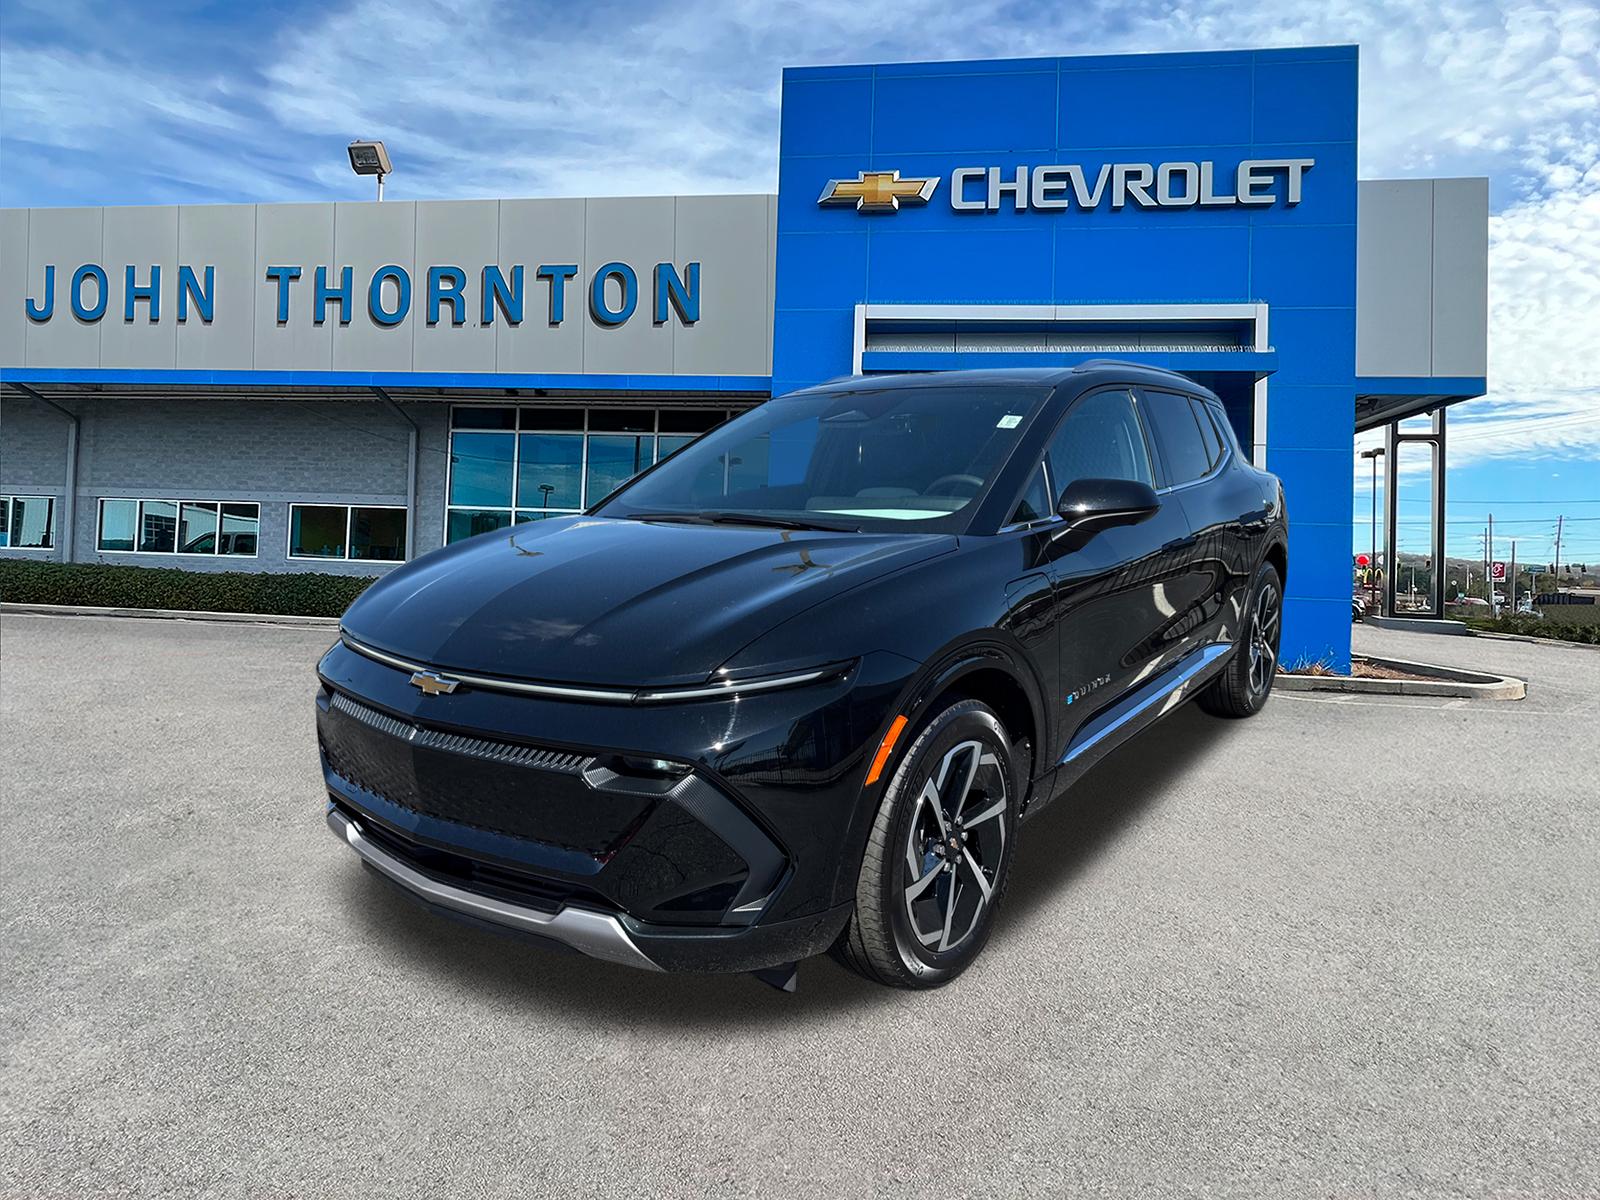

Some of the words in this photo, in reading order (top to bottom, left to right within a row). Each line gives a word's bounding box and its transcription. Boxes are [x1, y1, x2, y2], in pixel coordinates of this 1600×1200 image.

[950, 158, 1316, 213] CHEVROLET
[26, 264, 214, 324] JOHN
[265, 261, 702, 329] THORNTON
